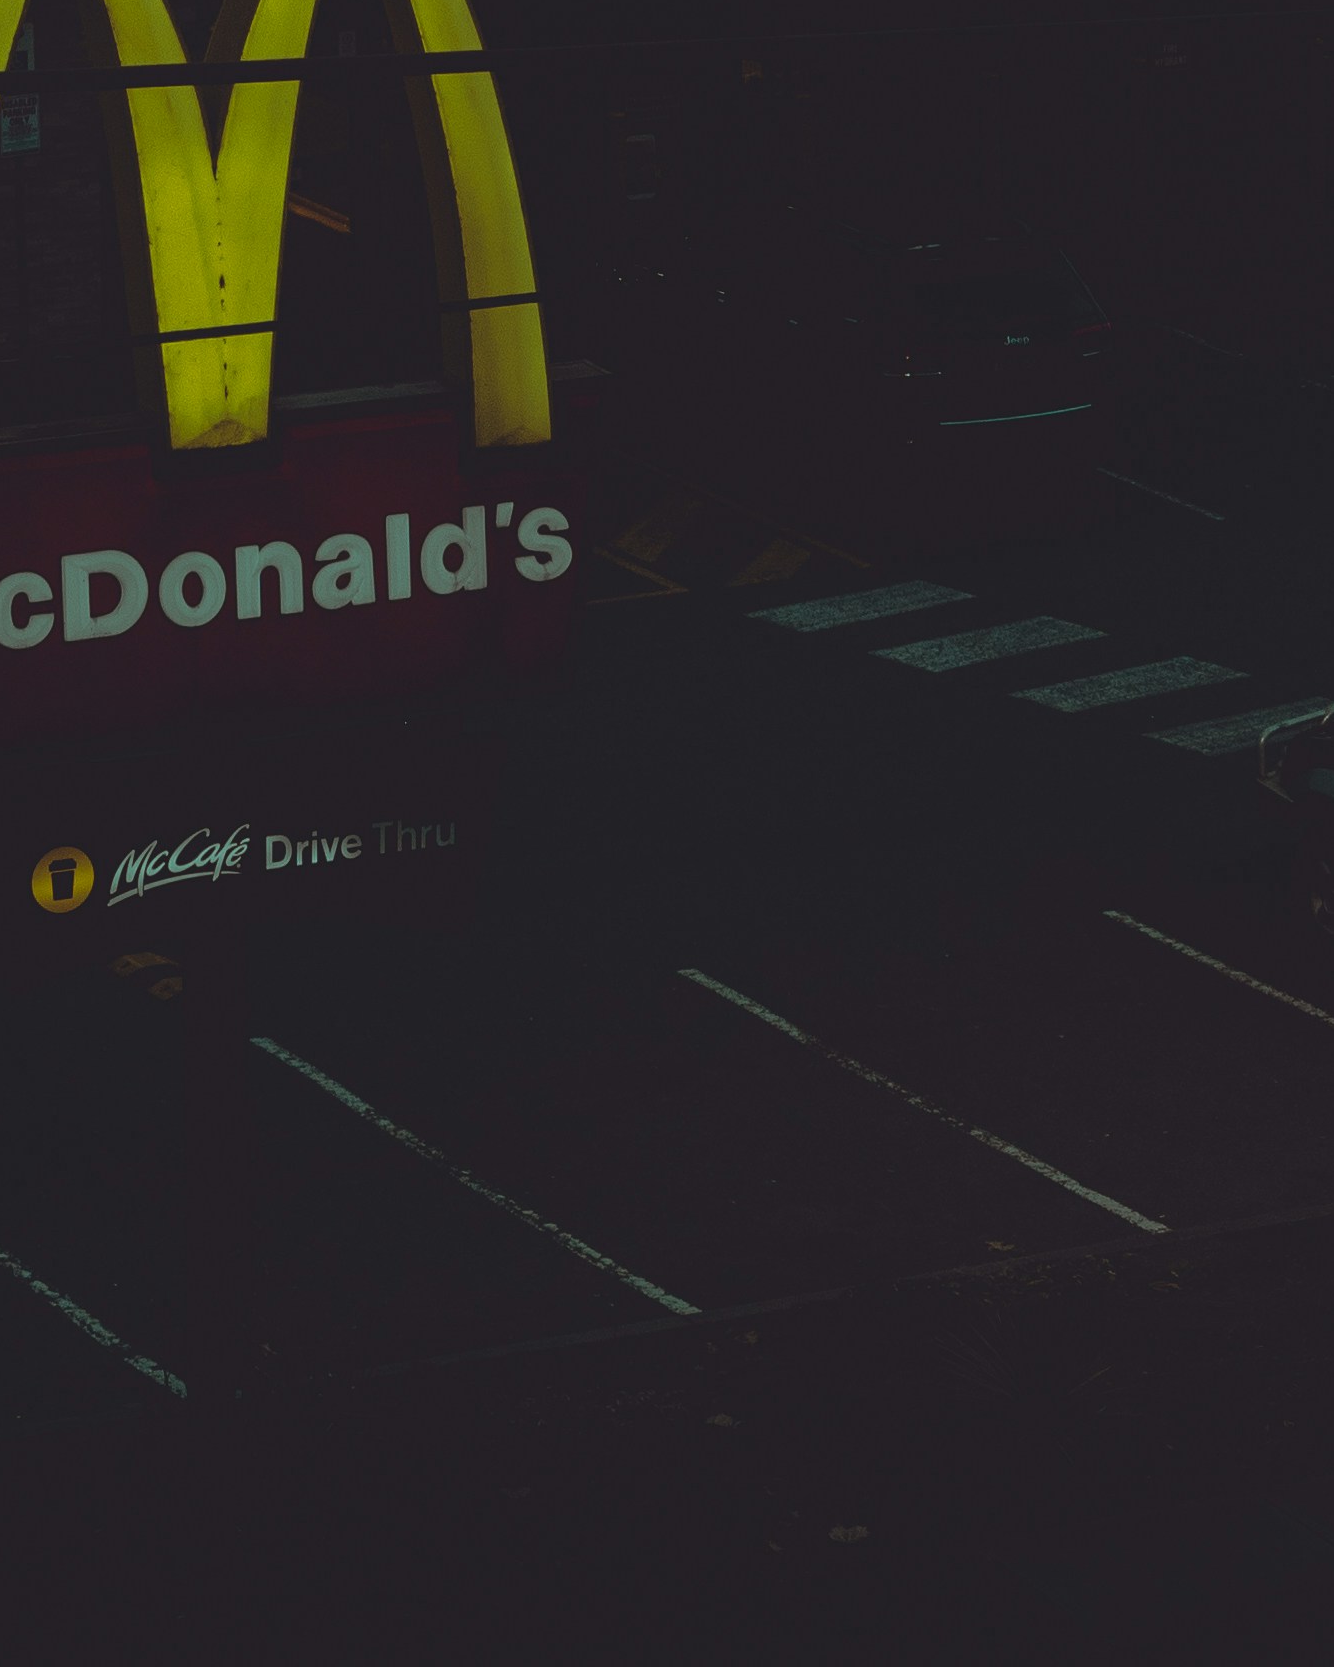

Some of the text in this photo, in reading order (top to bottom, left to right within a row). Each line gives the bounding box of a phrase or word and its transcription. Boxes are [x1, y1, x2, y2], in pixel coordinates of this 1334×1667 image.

[107, 820, 457, 906] McCafé Drive Thru
